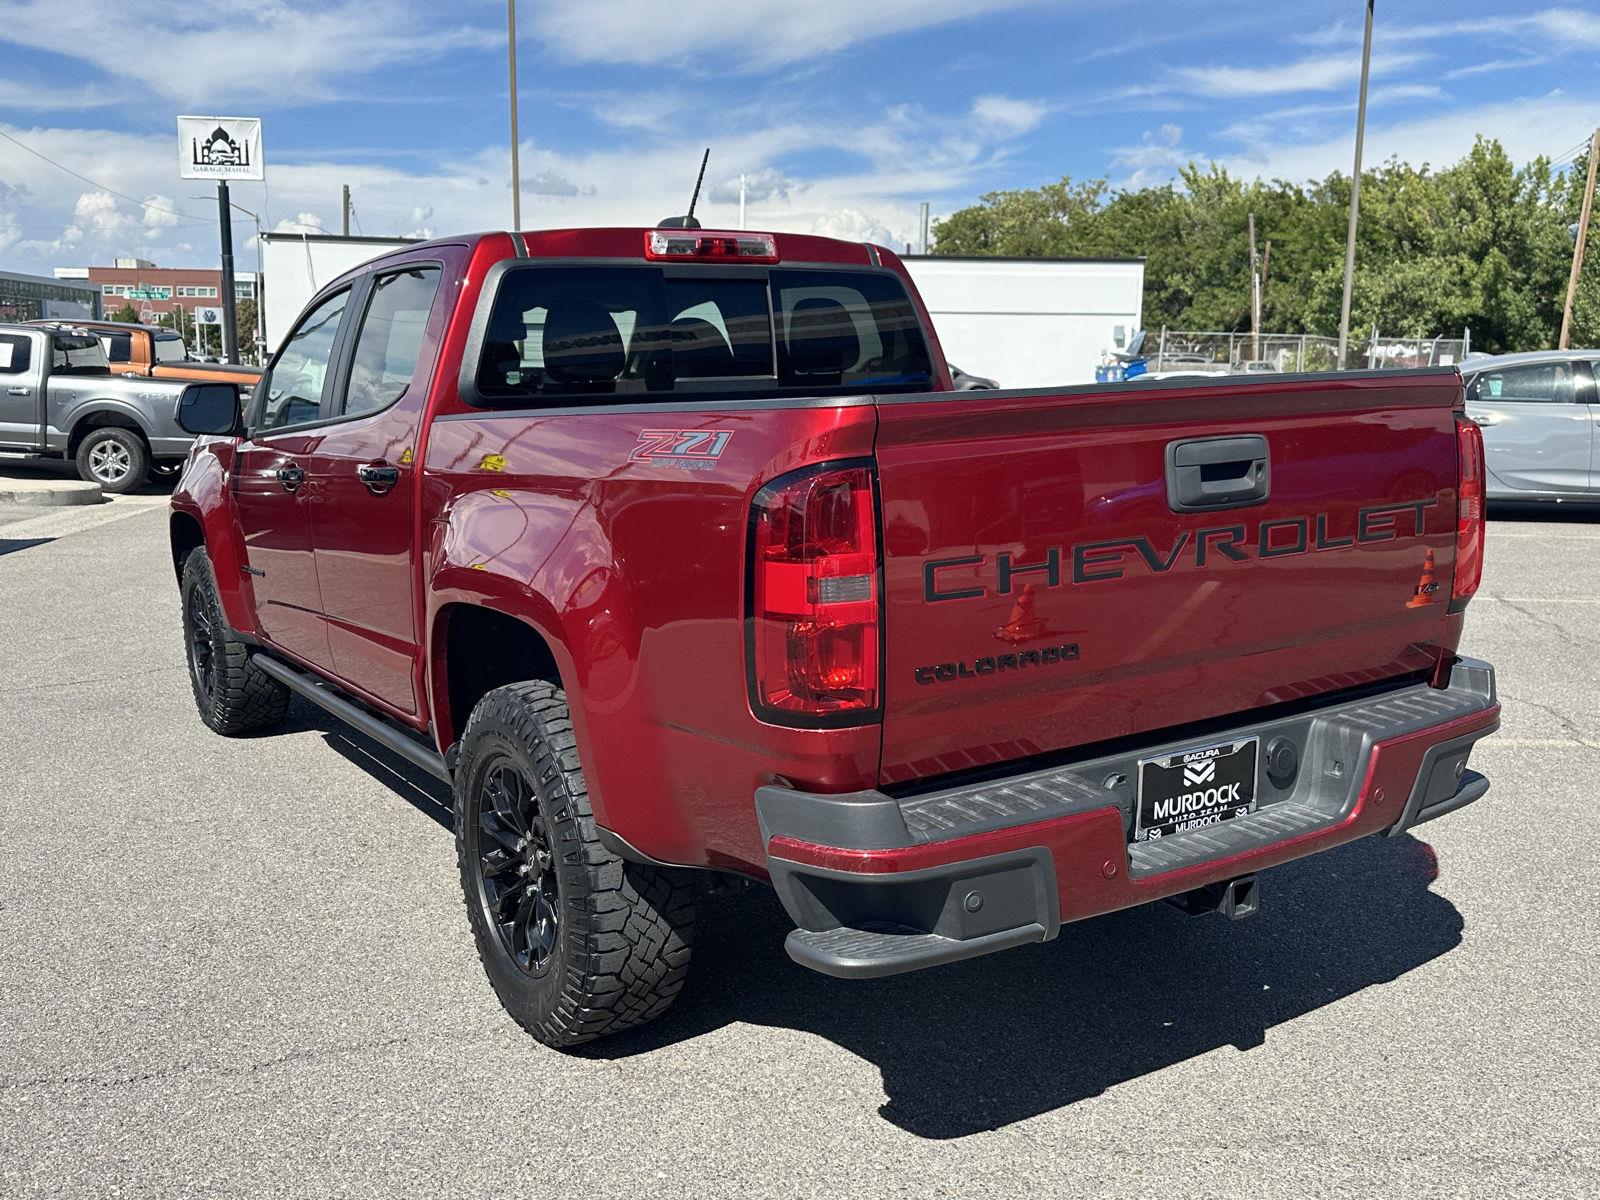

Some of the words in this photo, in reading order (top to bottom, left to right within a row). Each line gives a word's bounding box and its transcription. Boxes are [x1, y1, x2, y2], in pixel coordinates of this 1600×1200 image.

[923, 498, 1438, 603] CHEVROLET
[914, 643, 1080, 685] COLORADO
[1188, 749, 1220, 762] ACURA
[1153, 782, 1240, 820] MURDOCK
[1175, 813, 1222, 834] MURDOCK
